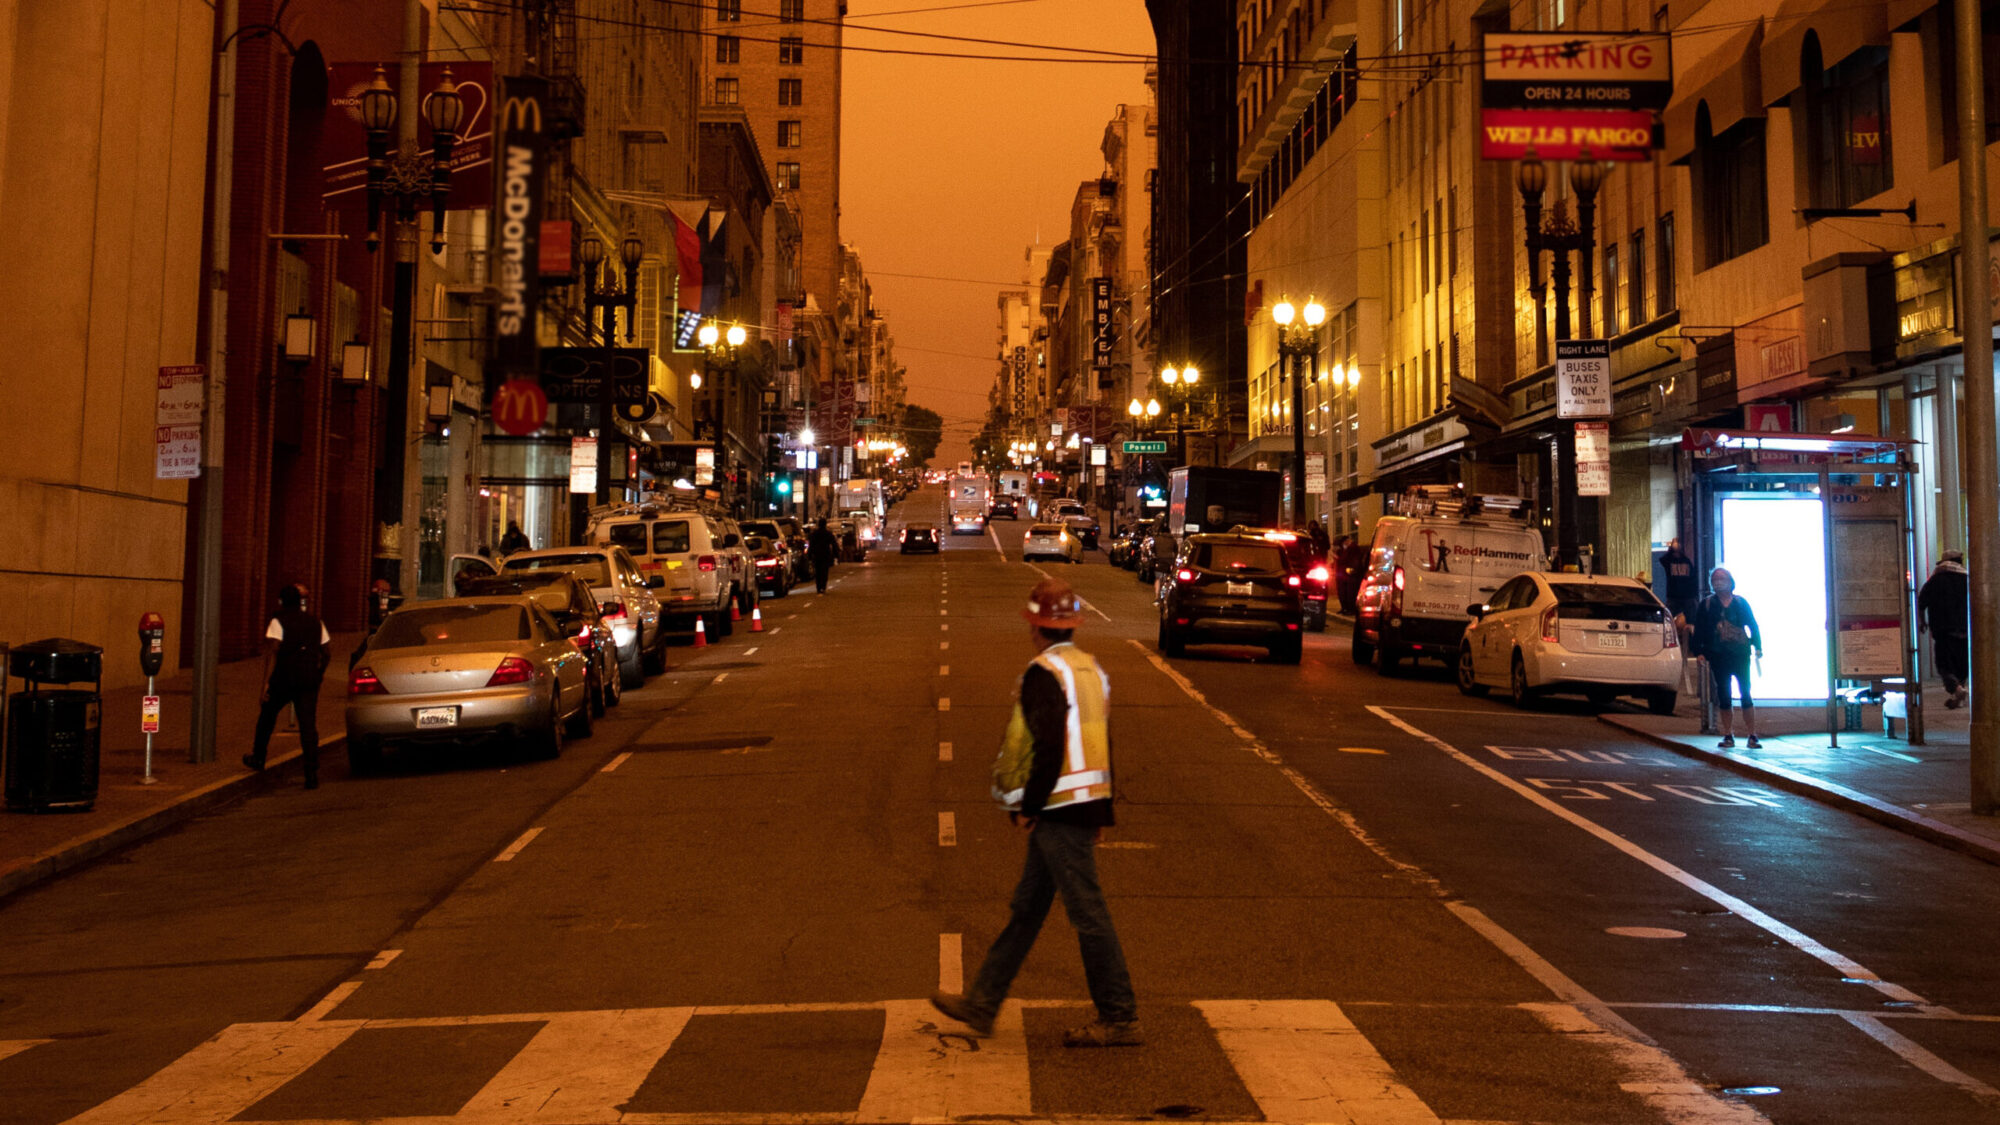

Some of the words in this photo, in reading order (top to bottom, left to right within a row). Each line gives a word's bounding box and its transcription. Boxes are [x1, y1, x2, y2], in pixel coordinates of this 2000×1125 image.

[1501, 44, 1652, 69] PARKING
[1525, 87, 1561, 100] OPEN
[1565, 88, 1582, 99] 24
[1586, 87, 1631, 100] HOURS
[1486, 126, 1566, 144] WELLS
[1571, 127, 1649, 146] FARGO
[1098, 284, 1109, 367] EMBLEM
[1901, 306, 1942, 337] BOUTIQUE
[1559, 346, 1582, 354] RIGHT
[1585, 345, 1606, 354] LANE
[1769, 342, 1794, 377] ALESSI
[1566, 362, 1600, 372] BUSES
[160, 377, 171, 387] NO
[1570, 374, 1598, 384] TAXIS
[1571, 386, 1597, 396] ONLY
[159, 428, 169, 440] NO
[172, 430, 198, 440] PARKING
[1129, 443, 1161, 451] Powell
[162, 458, 172, 467] TUE
[1578, 463, 1587, 472] NO
[1453, 544, 1532, 561] RedHammer
[1484, 746, 1678, 767] BUS
[1525, 778, 1786, 808] STOP
